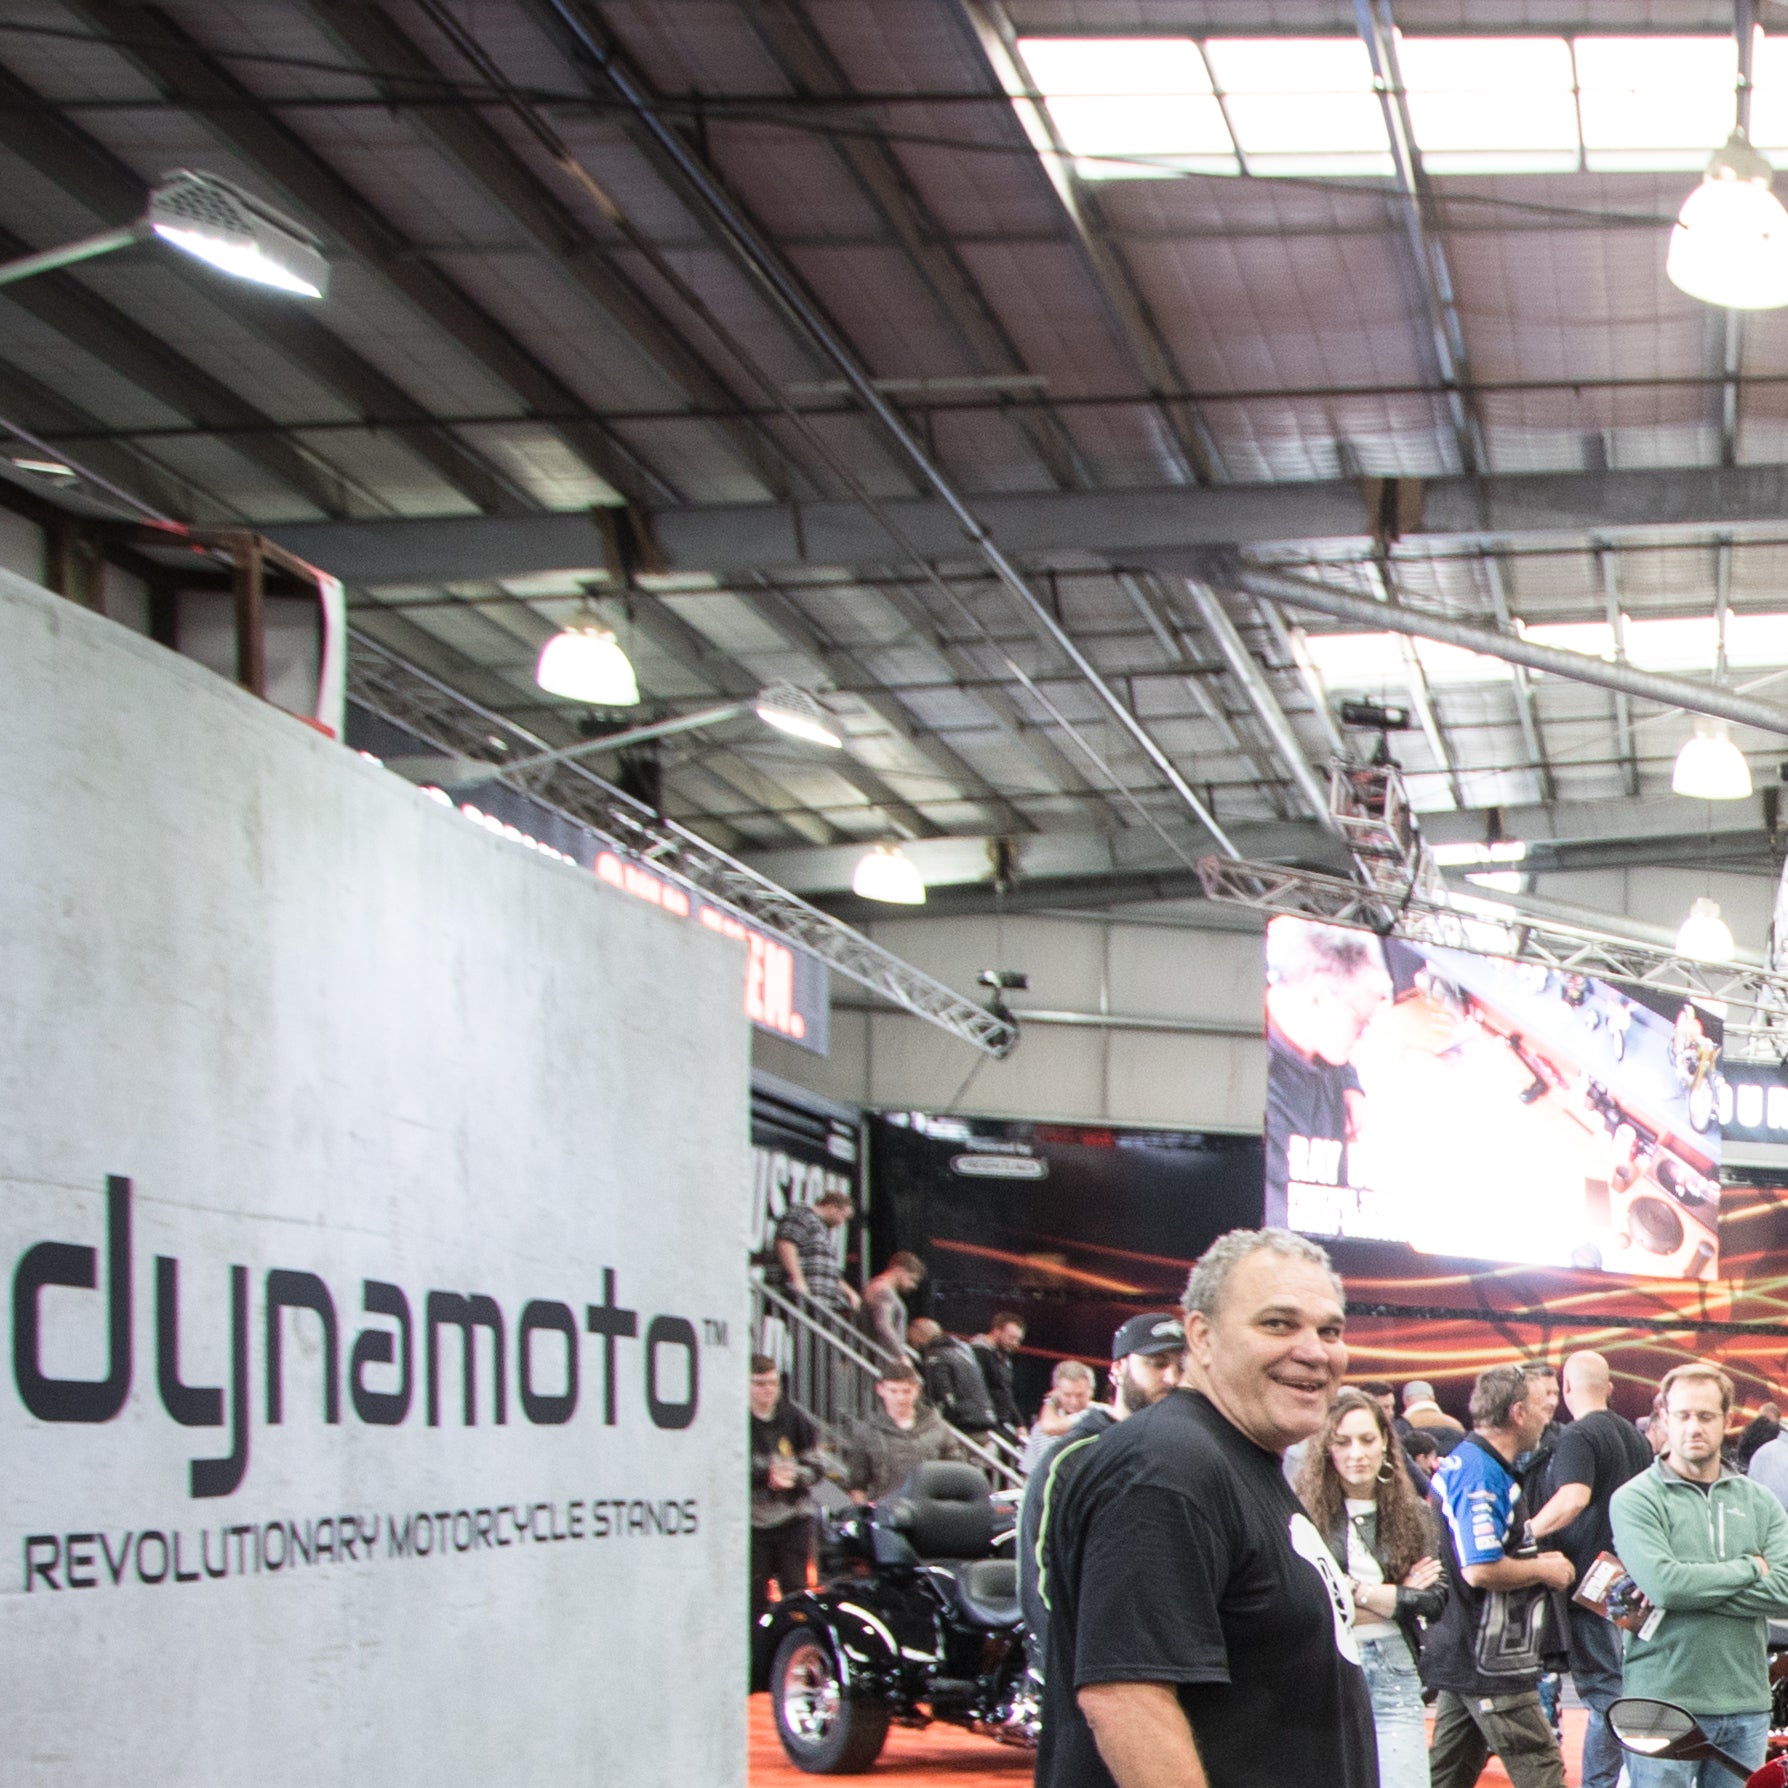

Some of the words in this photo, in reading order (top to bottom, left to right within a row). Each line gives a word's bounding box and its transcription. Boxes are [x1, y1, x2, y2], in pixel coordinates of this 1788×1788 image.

[13, 1174, 699, 1498] dynamoto
[24, 1515, 380, 1592] REVOLUTIONARY
[388, 1502, 585, 1558] MOTORCYCLE
[592, 1500, 698, 1537] STANDS
